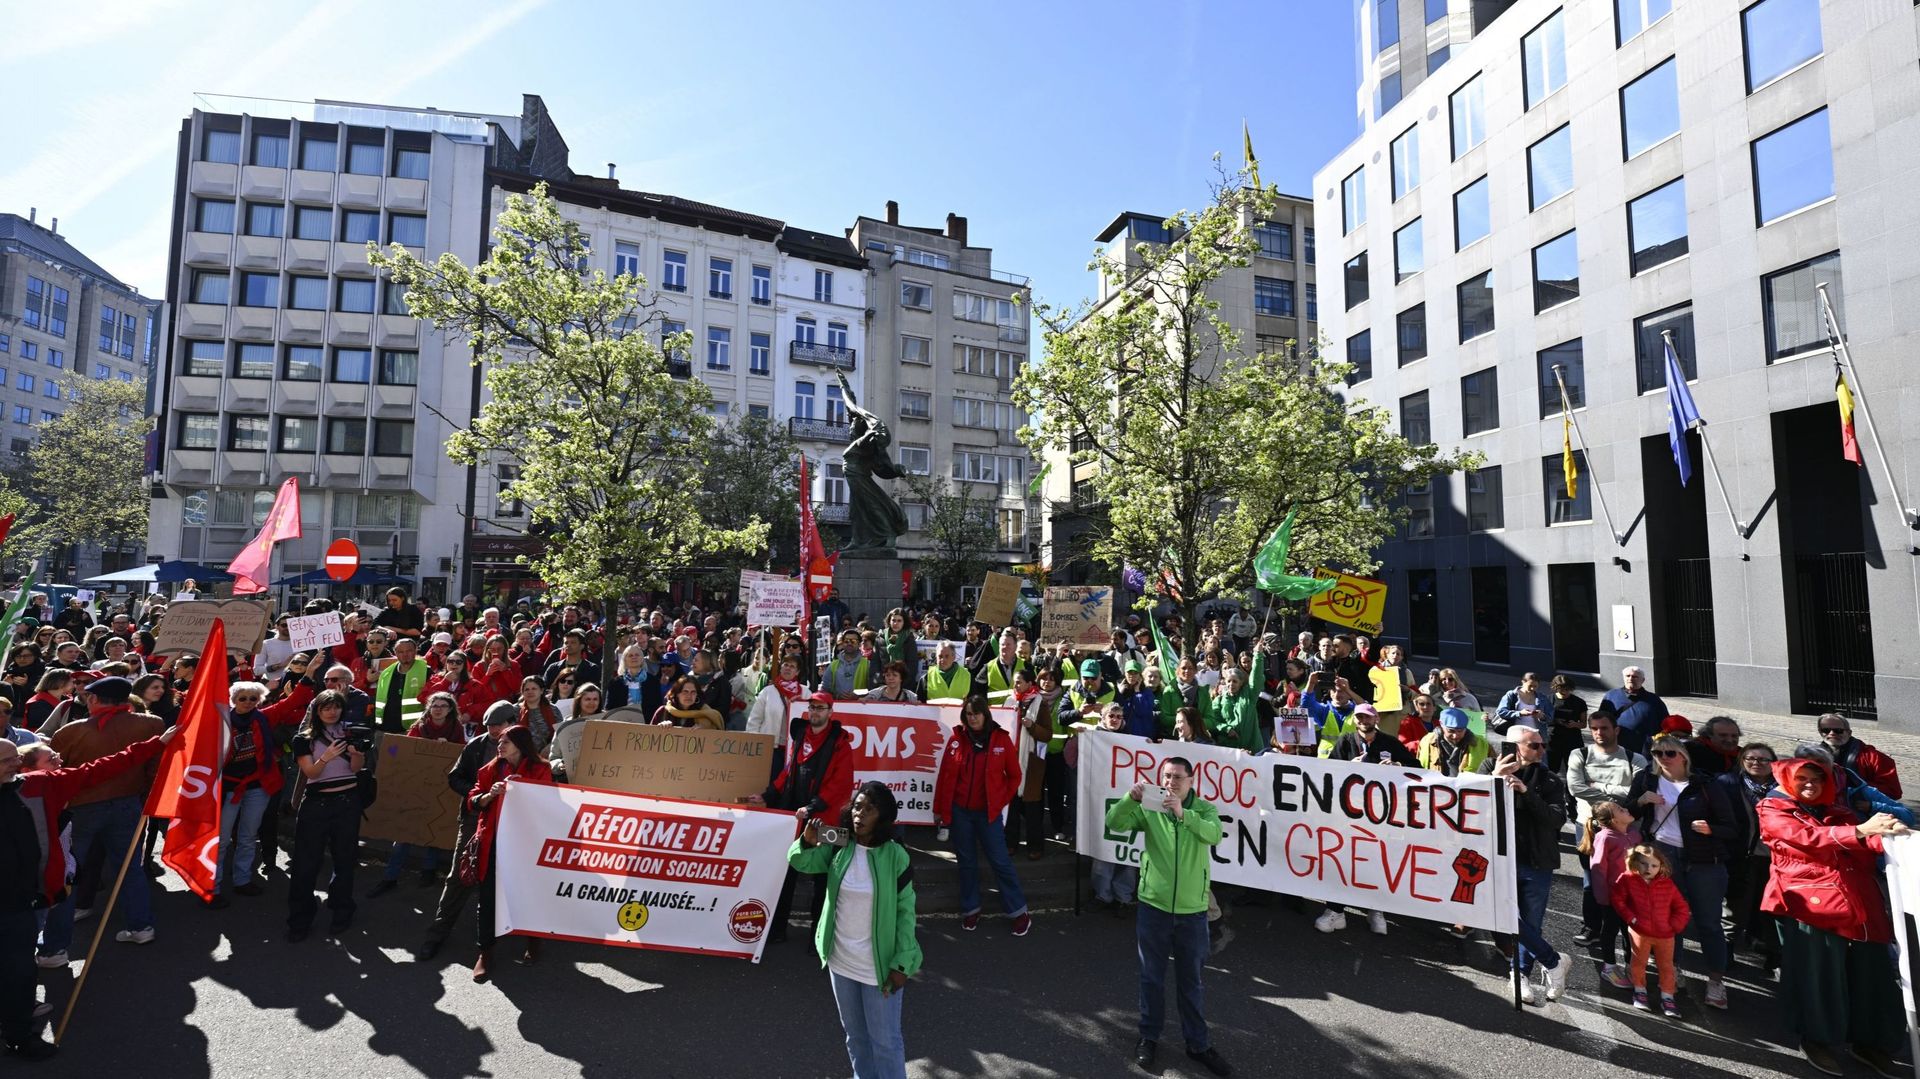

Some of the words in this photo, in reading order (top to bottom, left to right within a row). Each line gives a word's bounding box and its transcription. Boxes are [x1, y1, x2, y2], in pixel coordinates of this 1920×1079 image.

[1049, 613, 1078, 621] BOMBES
[293, 636, 317, 648] PETIT
[322, 632, 342, 645] FEU
[592, 731, 613, 750] LA
[625, 732, 706, 755] PROMOTION
[713, 738, 764, 757] SOCIALE
[632, 766, 654, 781] PAS
[662, 766, 685, 781] UNE
[698, 767, 736, 782] USINE
[909, 778, 918, 792] à
[921, 781, 933, 793] la
[907, 798, 930, 810] des
[1273, 764, 1333, 814] EN
[1339, 772, 1490, 835] COLÈRE
[575, 807, 692, 849] RÉFORME
[693, 825, 727, 853] DE
[544, 845, 561, 864] LA
[567, 847, 661, 875] PROMOTION
[666, 860, 729, 882] SOCIALE
[732, 865, 742, 882] ?
[1211, 814, 1267, 868] EN
[1284, 823, 1443, 903] GRÈVE
[556, 881, 571, 898] LA
[577, 883, 637, 905] GRANDE
